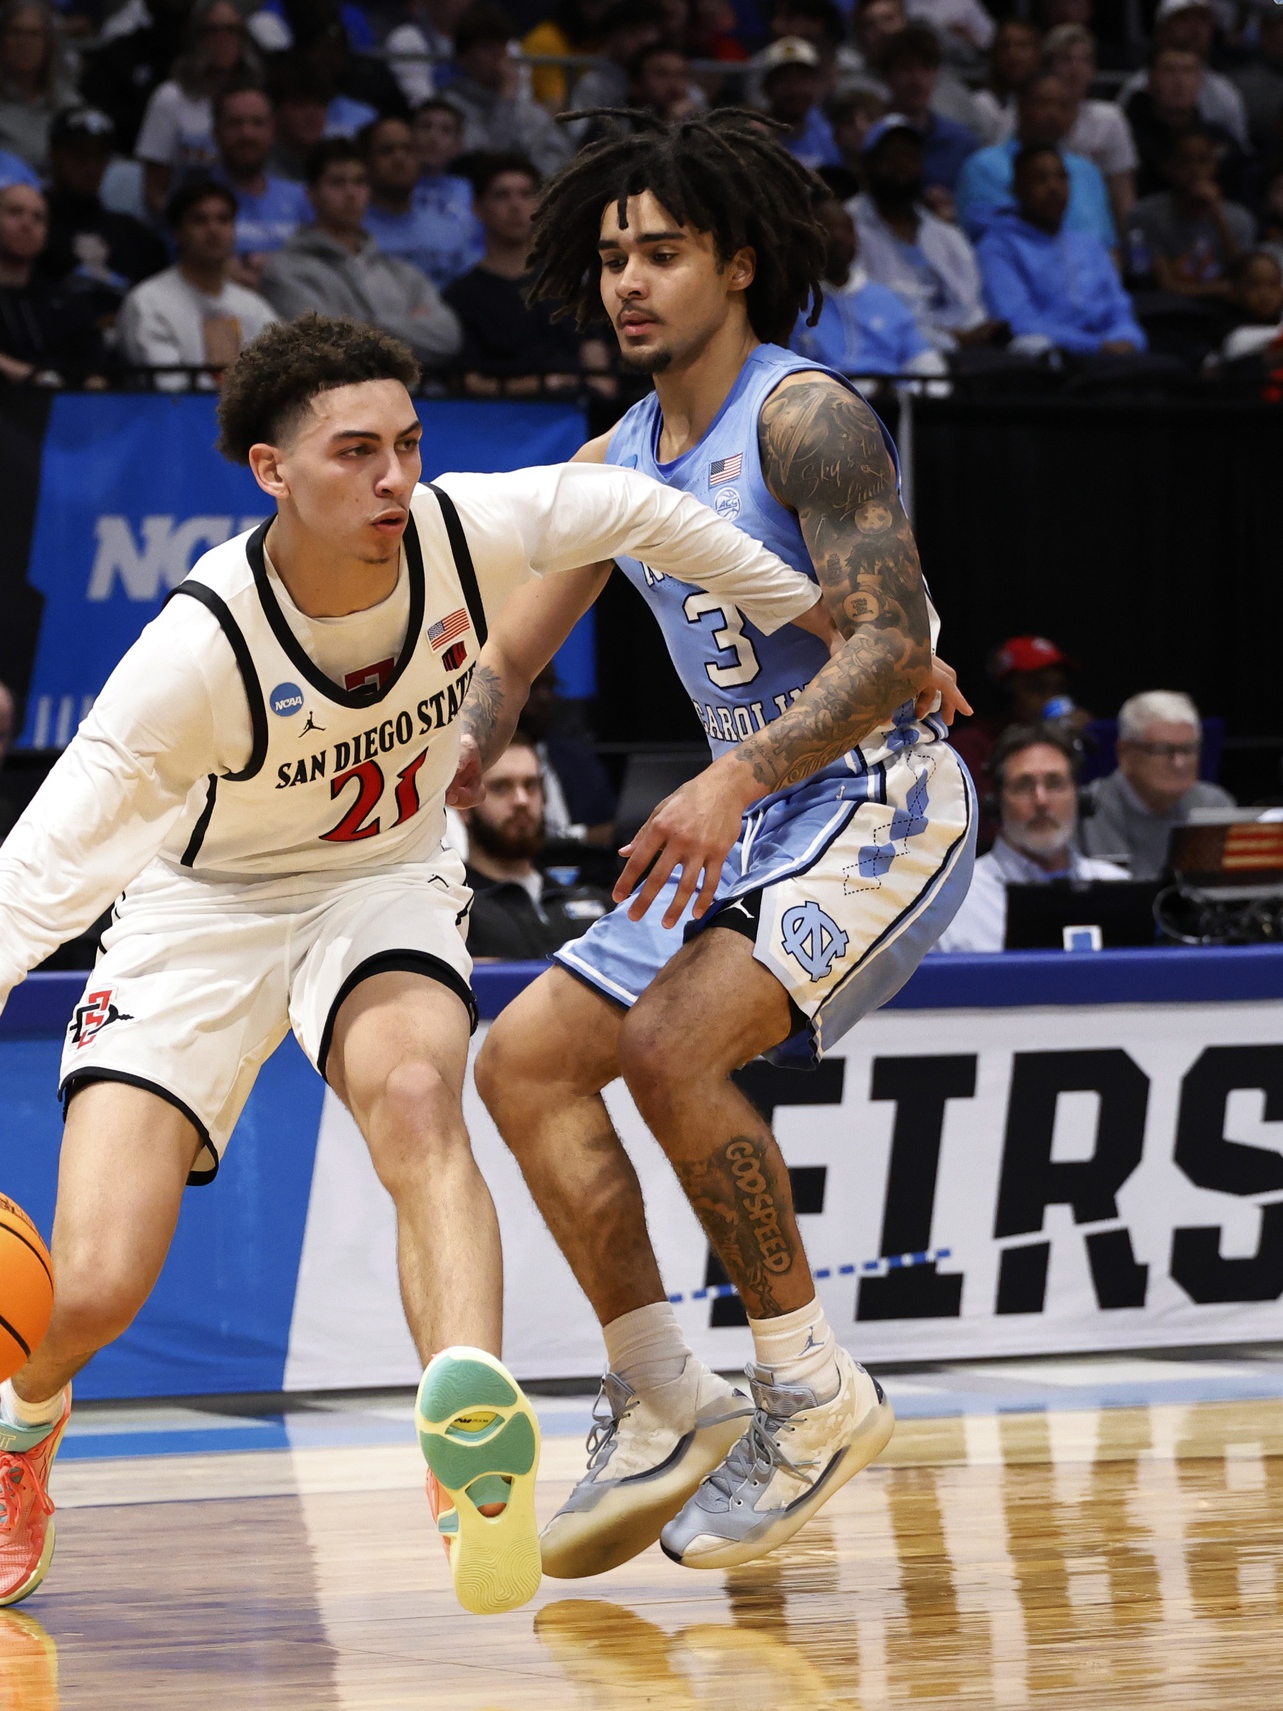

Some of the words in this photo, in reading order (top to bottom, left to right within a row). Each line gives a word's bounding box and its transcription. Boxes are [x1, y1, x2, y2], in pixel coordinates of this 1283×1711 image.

[86, 513, 269, 602] NC
[682, 590, 762, 689] 3
[275, 696, 302, 710] NCAA
[692, 682, 811, 744] CAROLI
[275, 750, 326, 789] SAN
[333, 711, 413, 772] DIEGO
[318, 746, 429, 842] 21
[725, 1140, 792, 1273] GODSPEED
